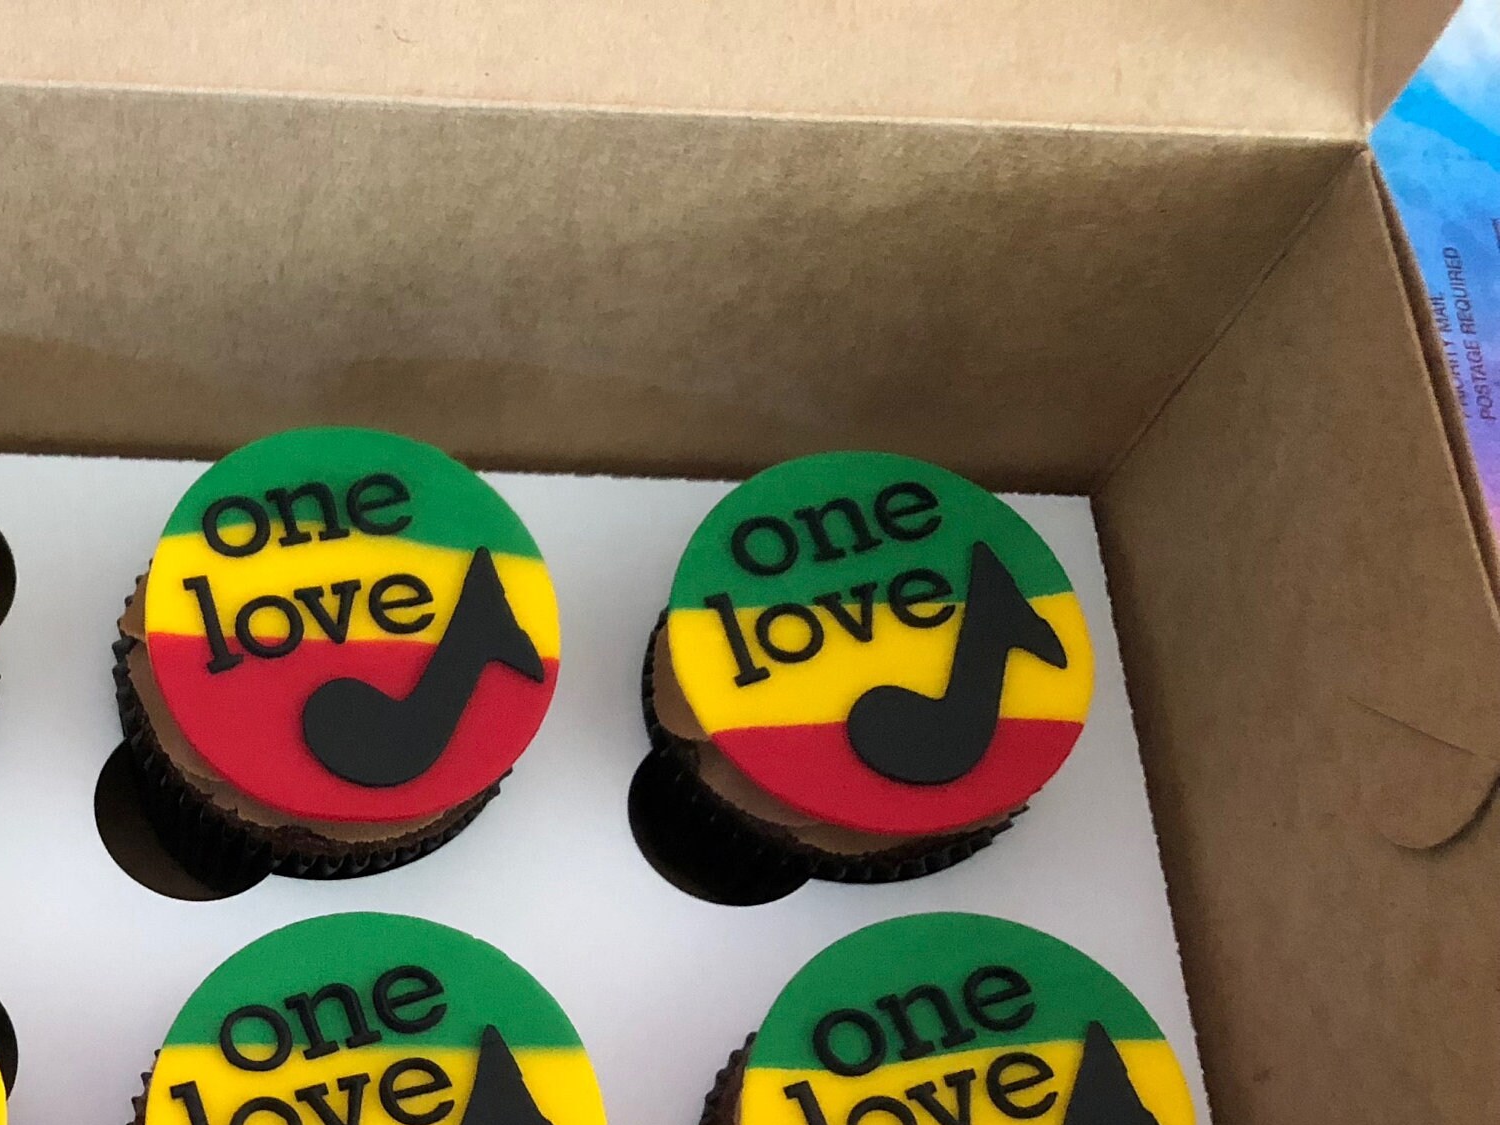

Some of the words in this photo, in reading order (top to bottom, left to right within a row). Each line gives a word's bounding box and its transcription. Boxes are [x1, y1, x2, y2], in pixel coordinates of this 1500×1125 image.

[1442, 247, 1477, 335] REQUIRED
[1464, 339, 1496, 420] POSTAGE
[202, 474, 411, 556] one
[731, 482, 942, 577] one
[185, 575, 433, 673] love
[704, 568, 955, 686] love
[219, 966, 446, 1071] one
[811, 965, 1036, 1076] one
